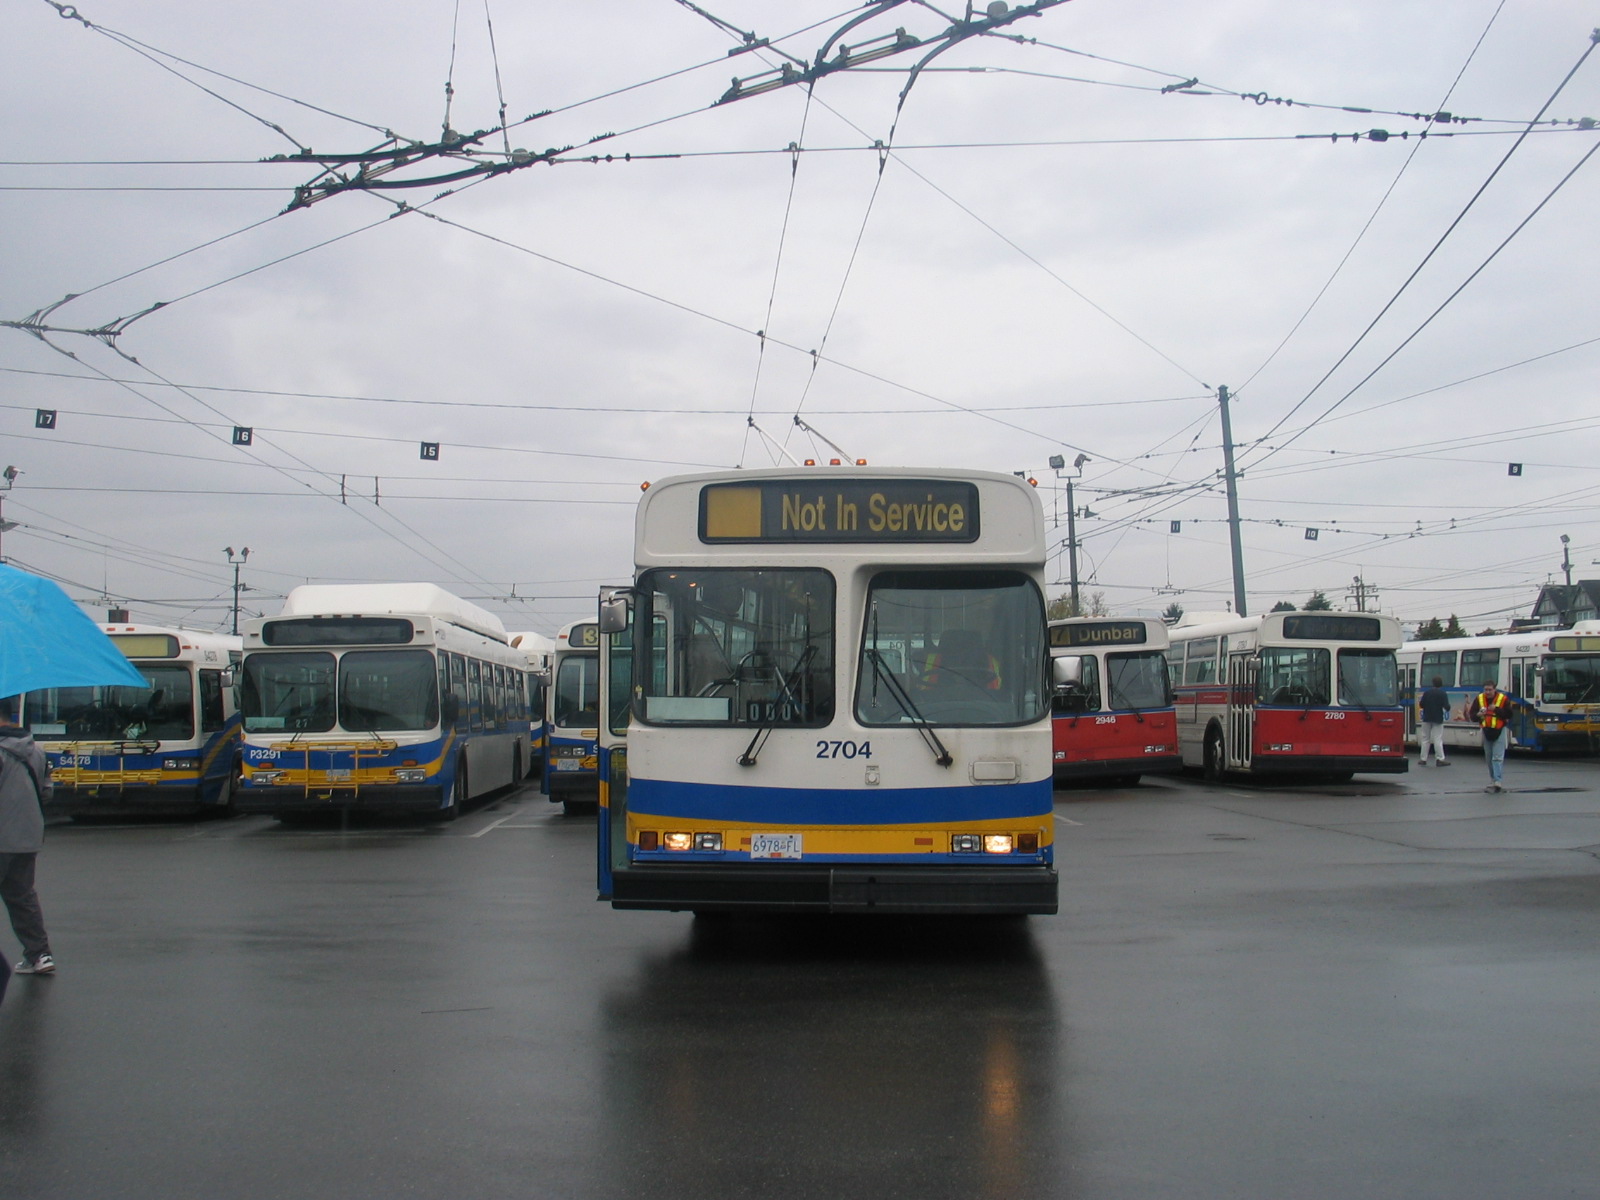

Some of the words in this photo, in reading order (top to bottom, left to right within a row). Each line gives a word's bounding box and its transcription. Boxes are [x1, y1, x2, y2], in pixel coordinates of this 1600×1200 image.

[39, 414, 53, 425] 17
[236, 431, 249, 442] 16
[423, 446, 436, 457] 15
[782, 494, 826, 531] Not
[836, 494, 857, 531] In
[868, 493, 964, 532] Service
[1307, 530, 1316, 538] 10
[1079, 626, 1139, 642] Dunbar
[1095, 715, 1116, 725] 2946
[1324, 711, 1345, 721] 2780
[250, 749, 281, 760] P3291
[816, 740, 873, 759] 2704
[753, 840, 780, 852] 6978
[786, 840, 800, 852] FL
